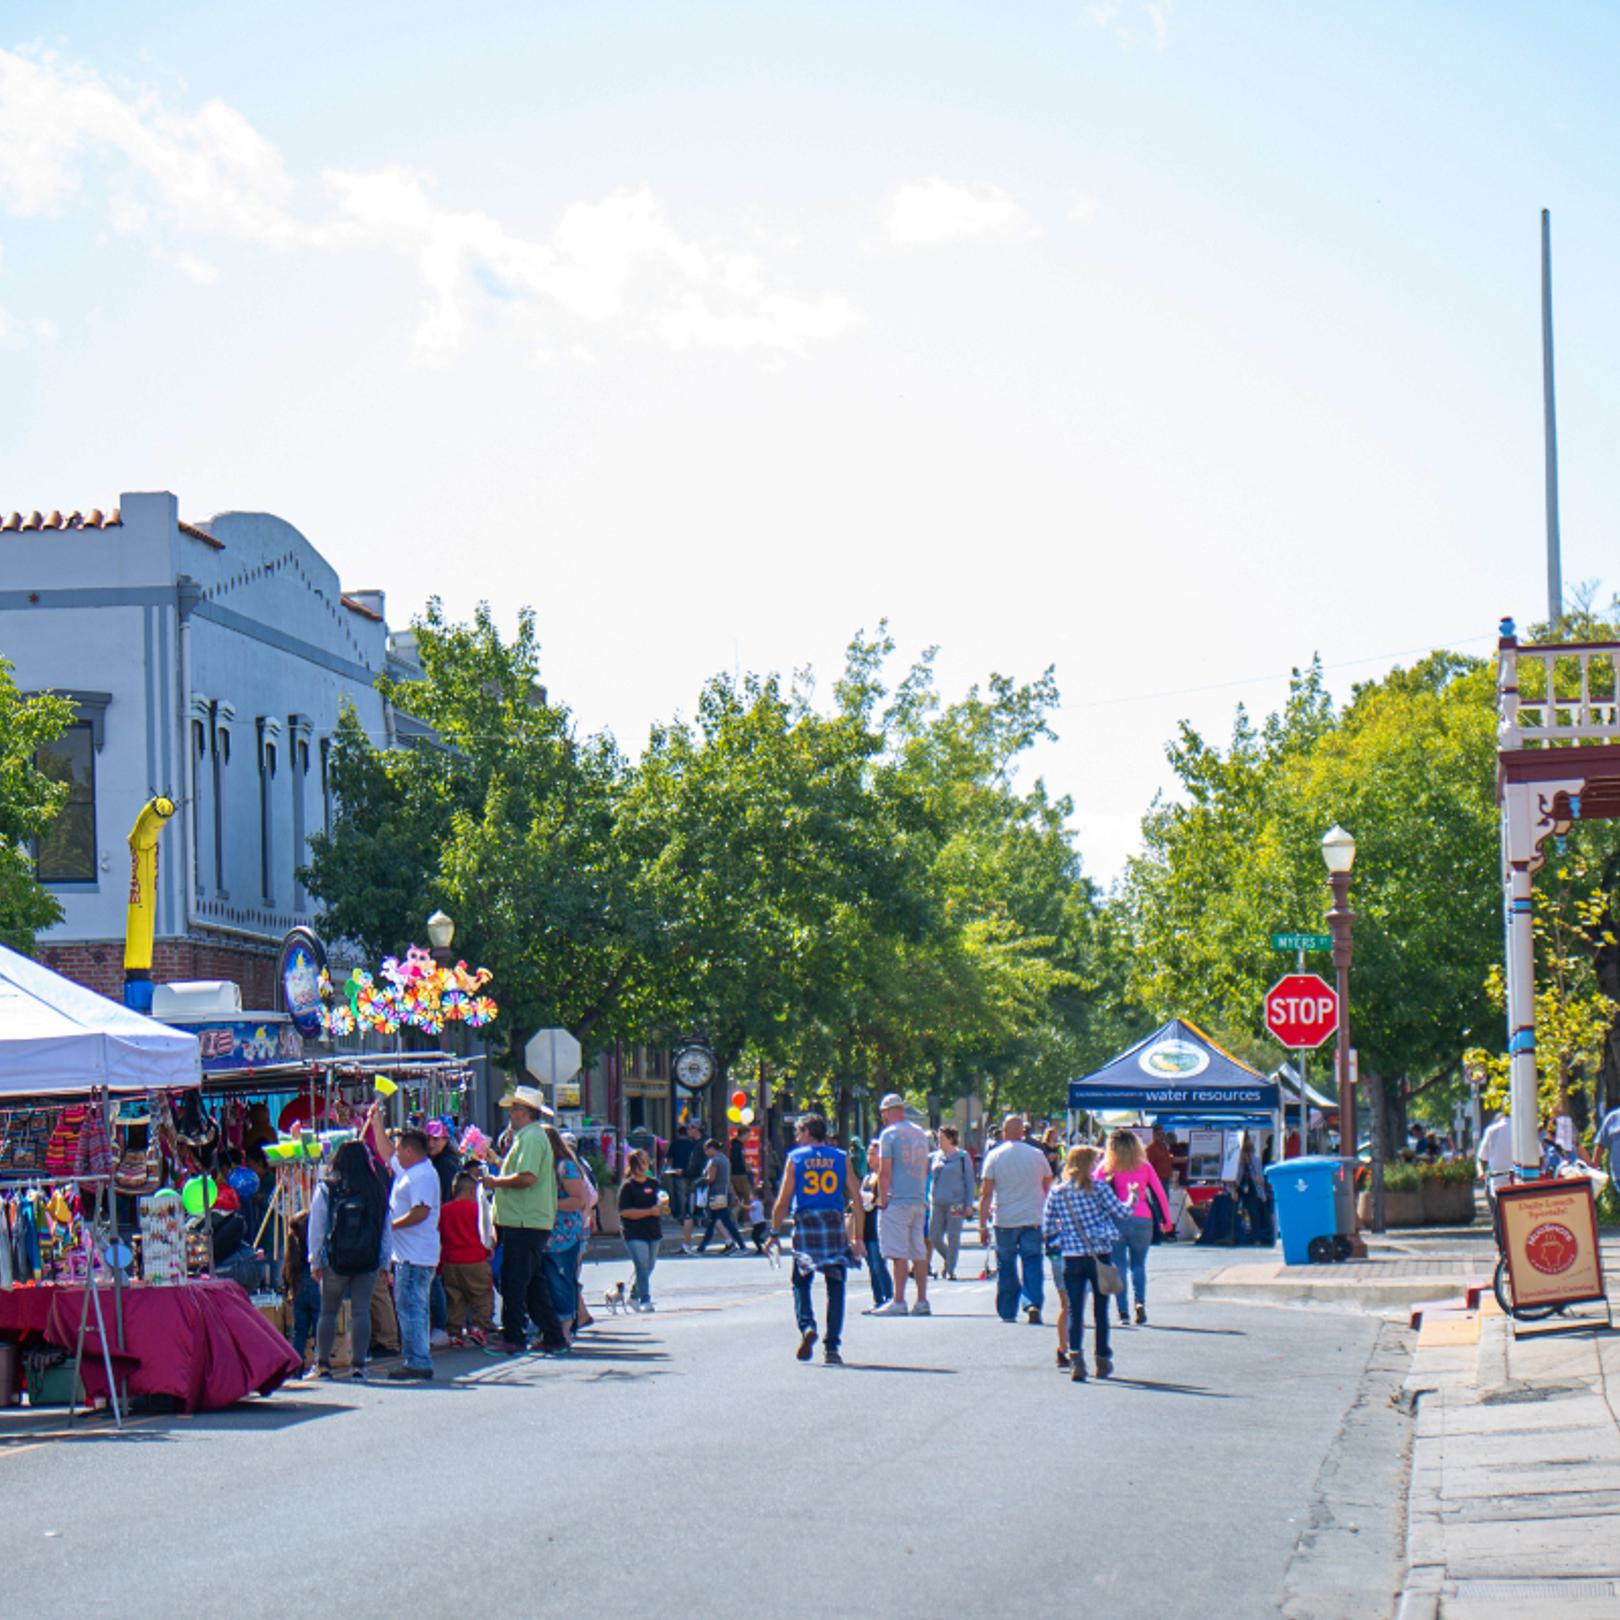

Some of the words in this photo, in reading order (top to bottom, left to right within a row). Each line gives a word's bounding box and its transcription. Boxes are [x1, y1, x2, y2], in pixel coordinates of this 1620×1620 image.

[1278, 936, 1316, 949] MYERS
[1270, 997, 1334, 1025] STOP
[1145, 1089, 1188, 1101] water
[1192, 1091, 1261, 1101] resources
[803, 1170, 838, 1195] 30
